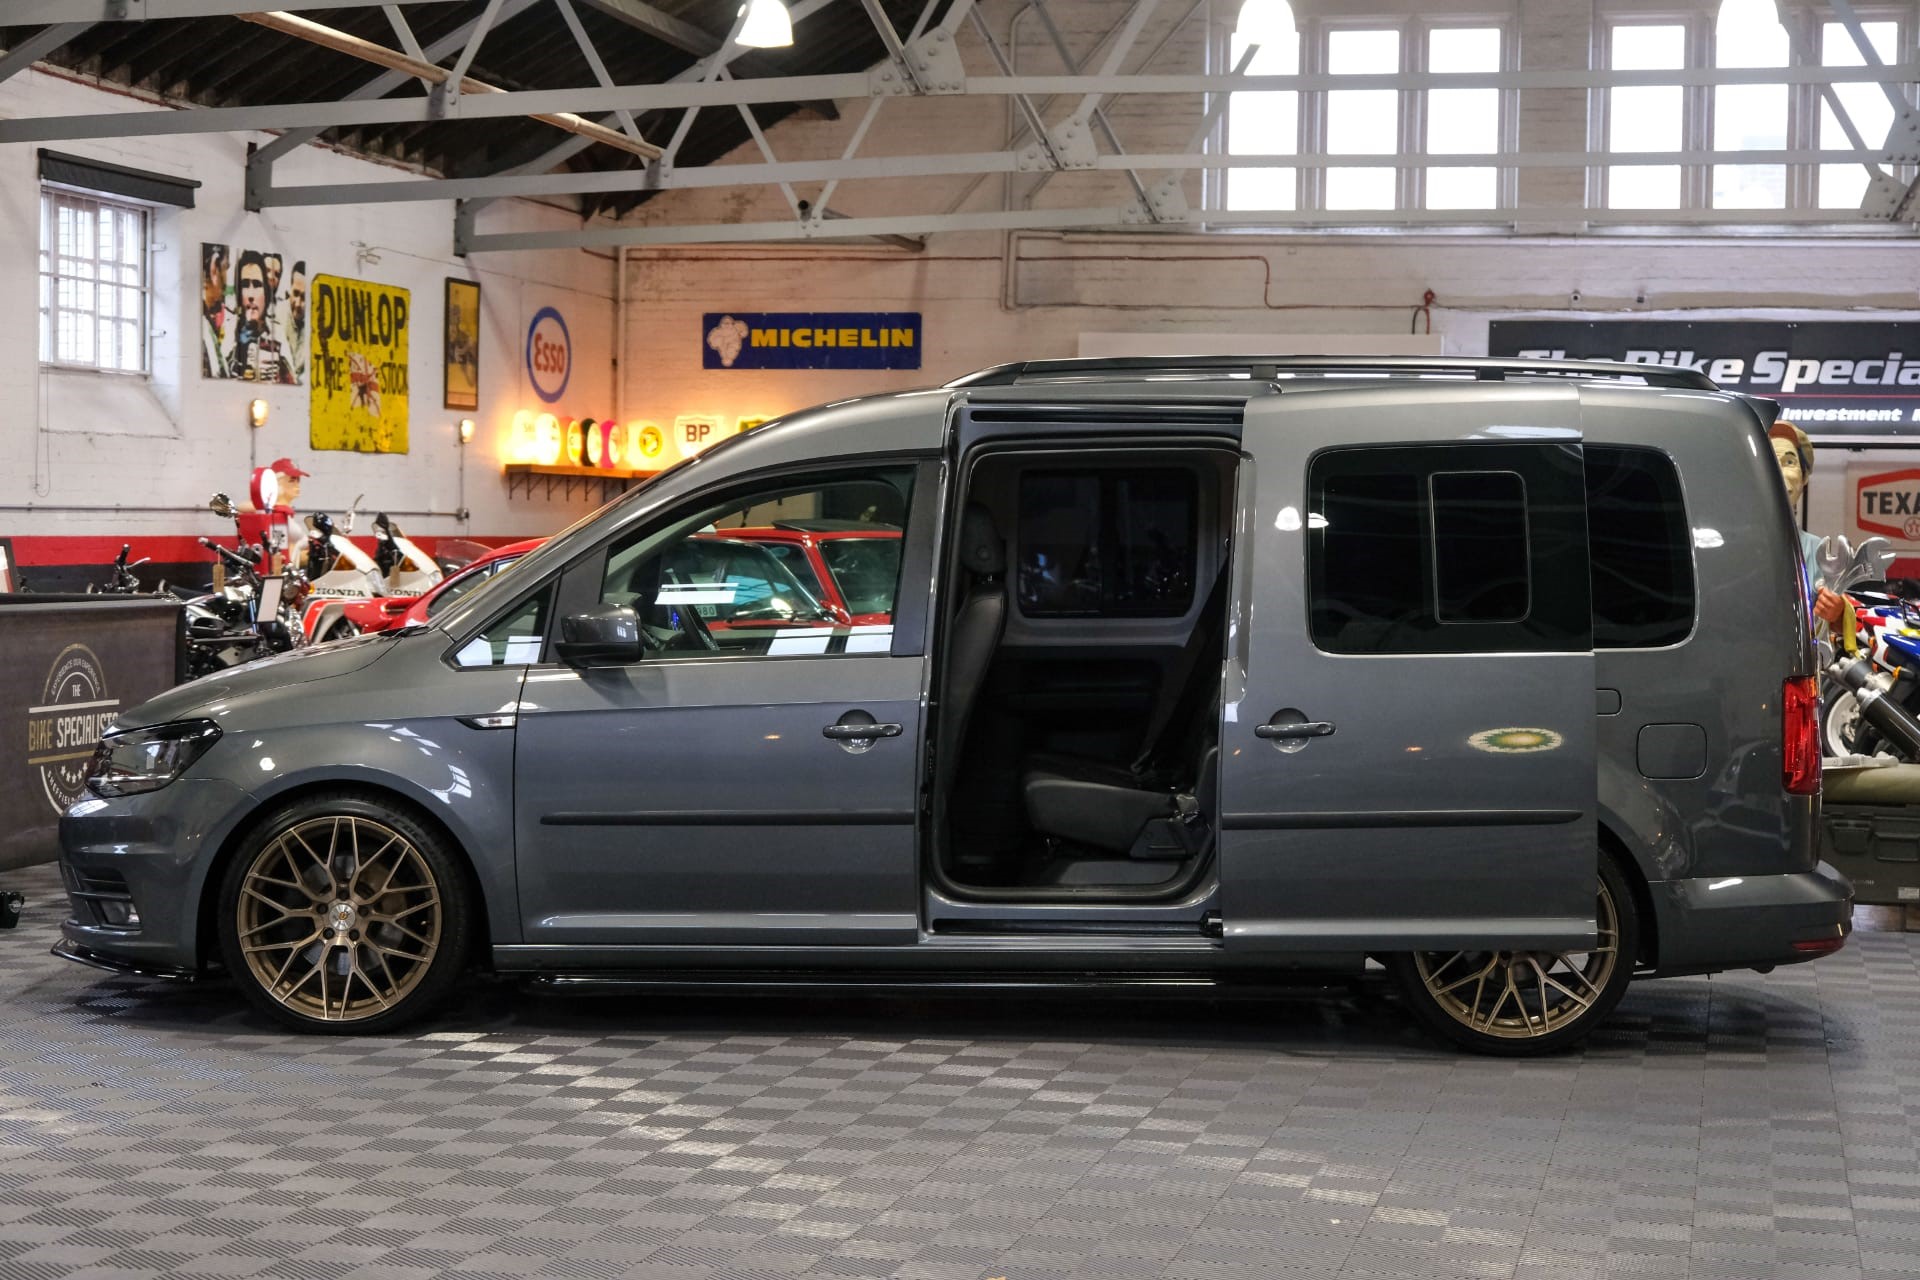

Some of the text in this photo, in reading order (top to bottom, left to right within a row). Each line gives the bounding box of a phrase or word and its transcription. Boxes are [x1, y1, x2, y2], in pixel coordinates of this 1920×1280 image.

[317, 283, 407, 349] DUNLOP
[751, 328, 914, 348] MICHELIN
[1750, 351, 1920, 393] Specia
[1781, 407, 1903, 422] Investment
[685, 424, 710, 442] BP
[316, 587, 366, 597] HONDA
[386, 588, 426, 597] OND
[72, 684, 80, 697] THE
[29, 712, 119, 752] BIKE SPECIALIS
